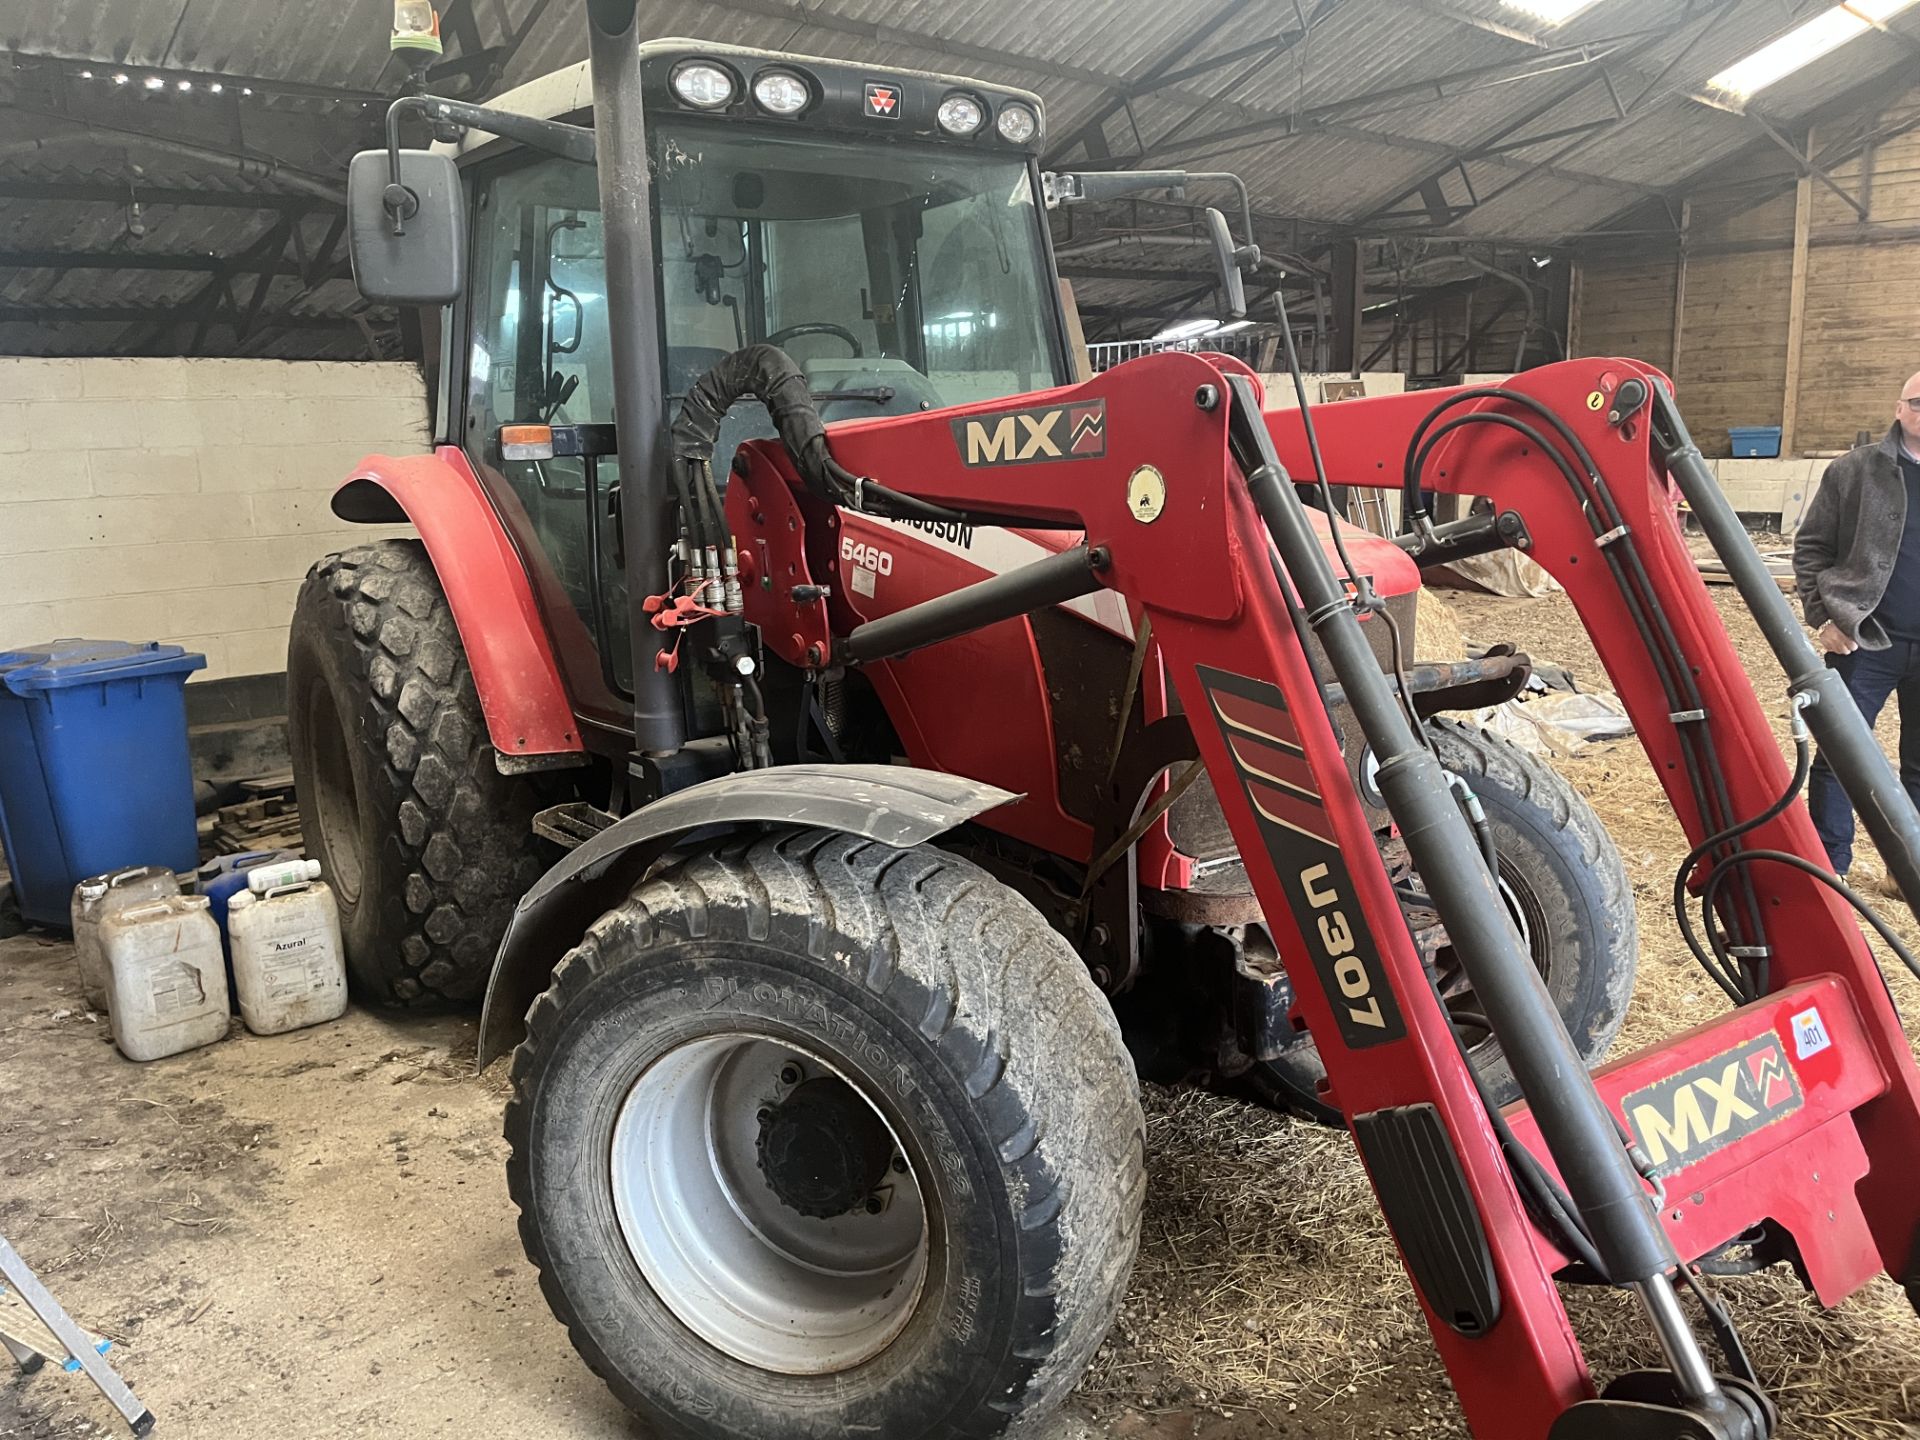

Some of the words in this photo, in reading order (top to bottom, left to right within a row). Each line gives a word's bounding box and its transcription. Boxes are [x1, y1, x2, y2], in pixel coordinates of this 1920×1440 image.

[967, 410, 1063, 464] MX
[841, 536, 893, 577] 5460
[274, 937, 307, 952] Azural
[1300, 862, 1386, 1029] U307
[703, 975, 918, 1099] FLOTATION
[1803, 1024, 1824, 1048] 401
[1632, 1060, 1760, 1167] MX
